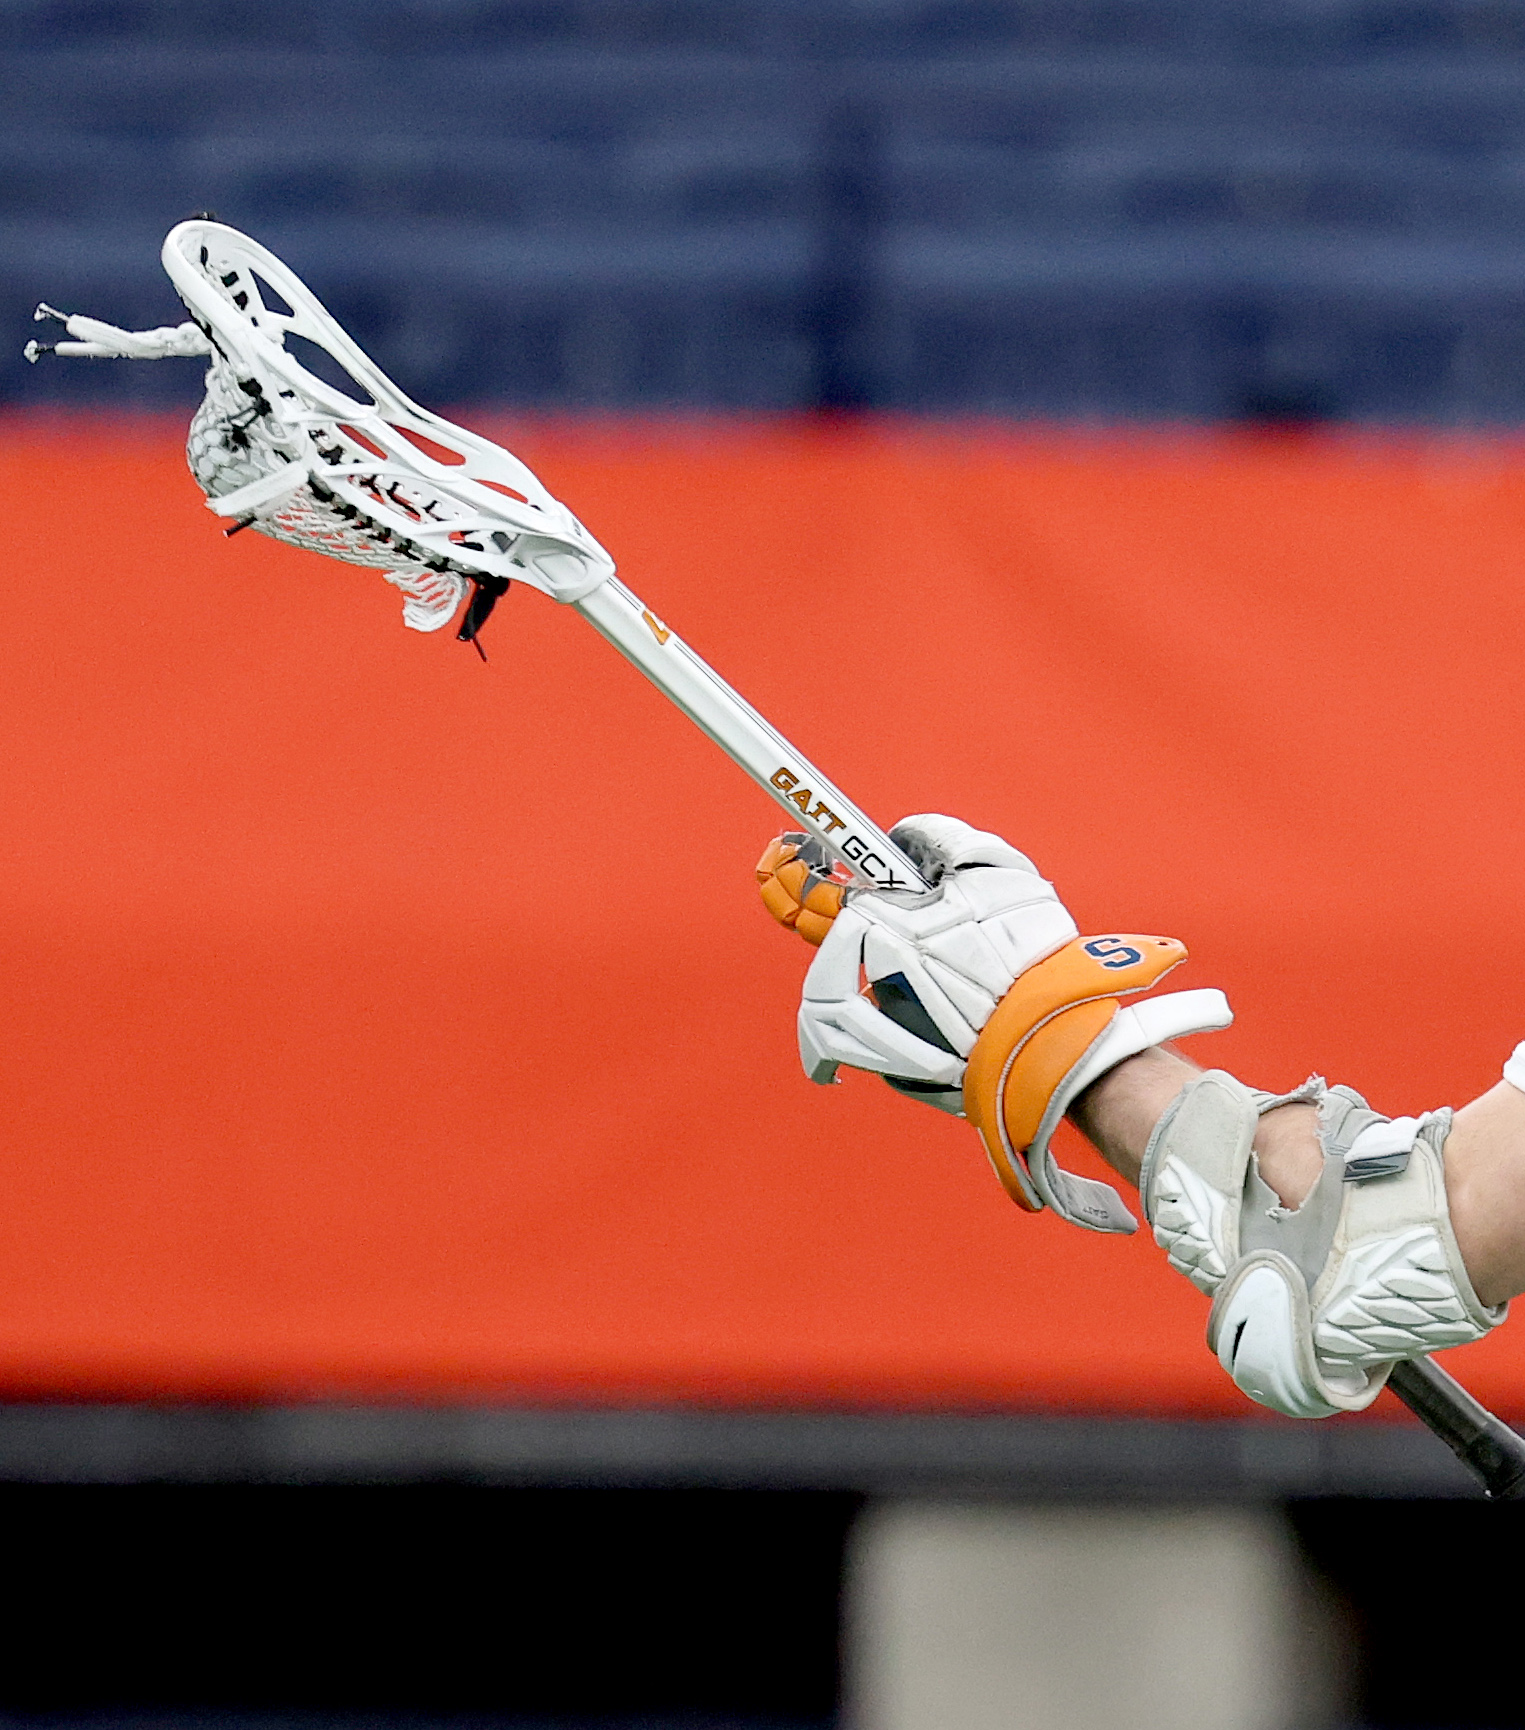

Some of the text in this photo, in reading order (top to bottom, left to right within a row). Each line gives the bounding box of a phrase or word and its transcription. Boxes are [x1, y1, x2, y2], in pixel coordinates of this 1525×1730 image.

[770, 767, 907, 887] GAIT GCX
[1083, 937, 1145, 971] S
